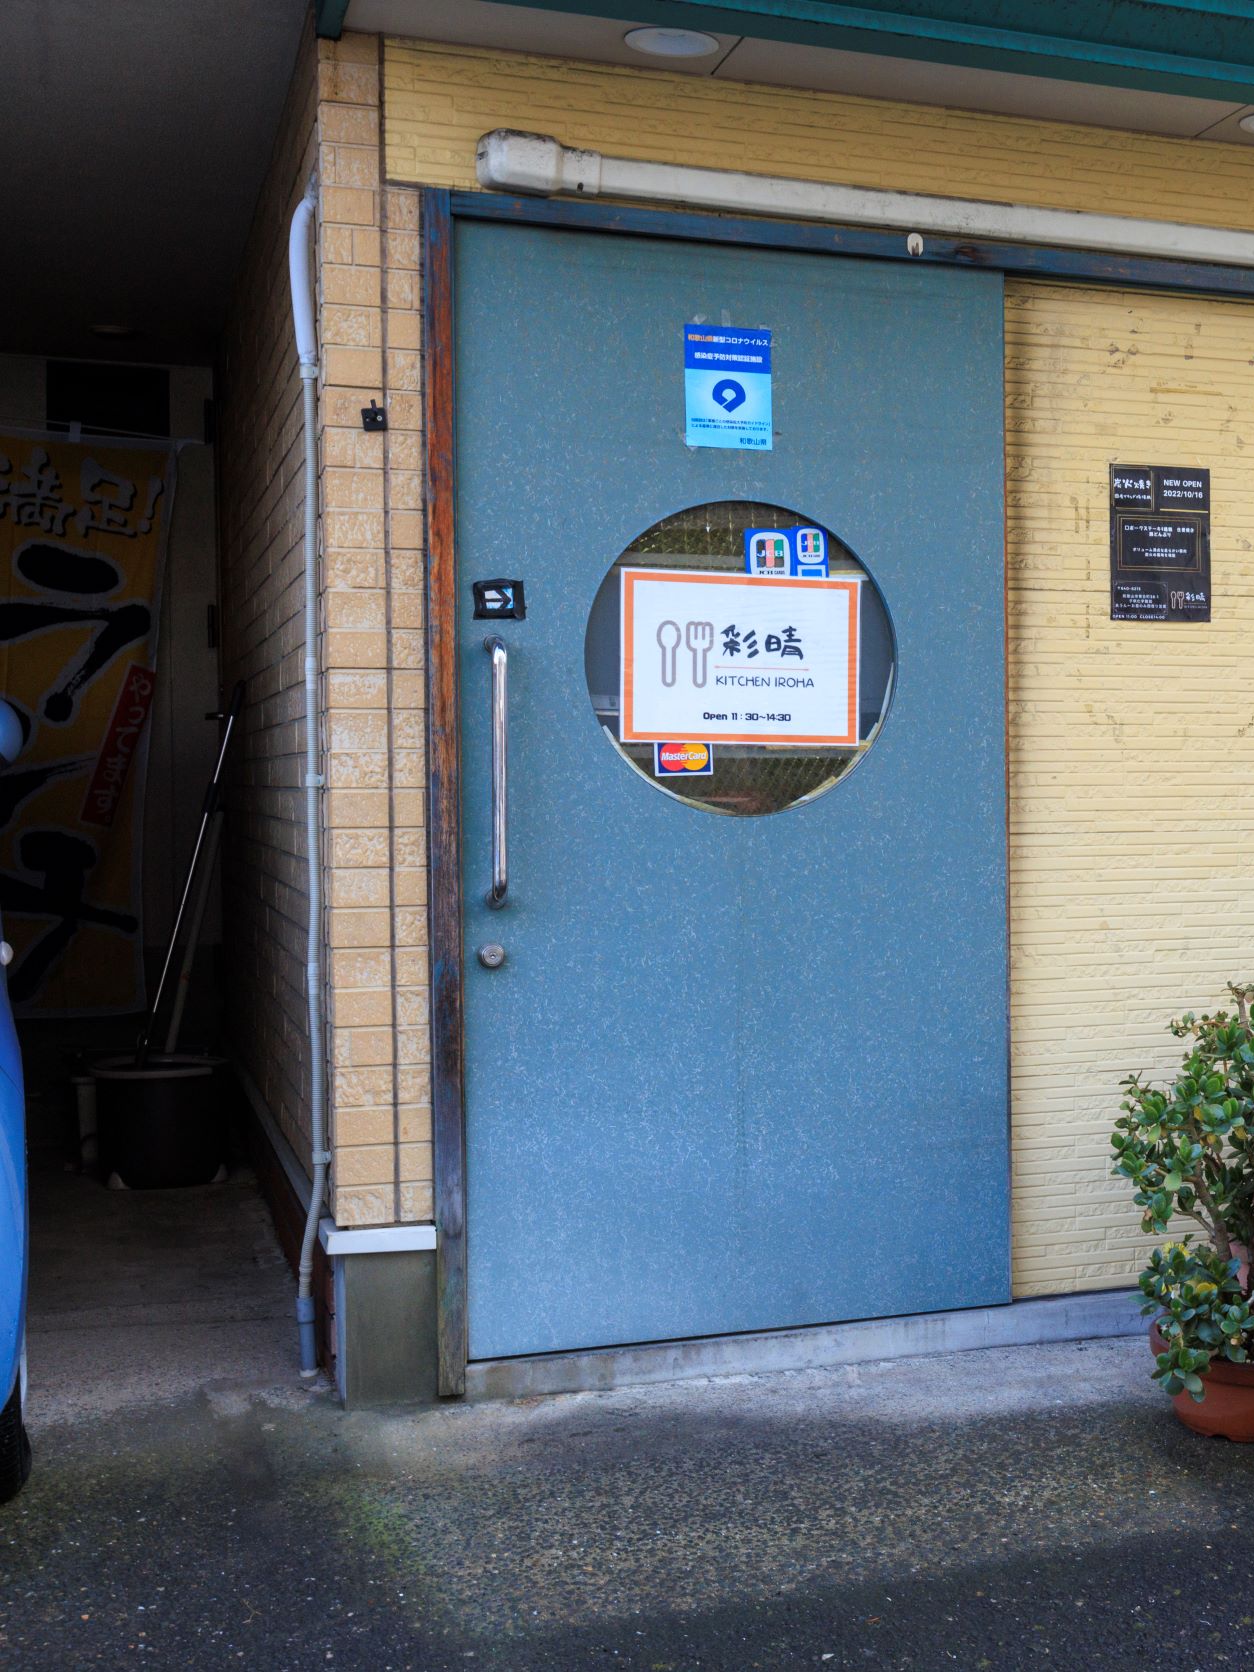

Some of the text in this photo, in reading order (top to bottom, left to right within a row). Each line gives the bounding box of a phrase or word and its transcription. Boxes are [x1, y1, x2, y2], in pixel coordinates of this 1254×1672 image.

[740, 437, 767, 446] 和歌山県
[1113, 478, 1151, 490] 炭火焼き
[1164, 479, 1202, 488] NEW OPEN
[720, 624, 804, 660] 彩晴
[715, 675, 814, 688] KITCHEN IROHA
[703, 712, 728, 723] Open
[660, 750, 707, 762] MasterCard
